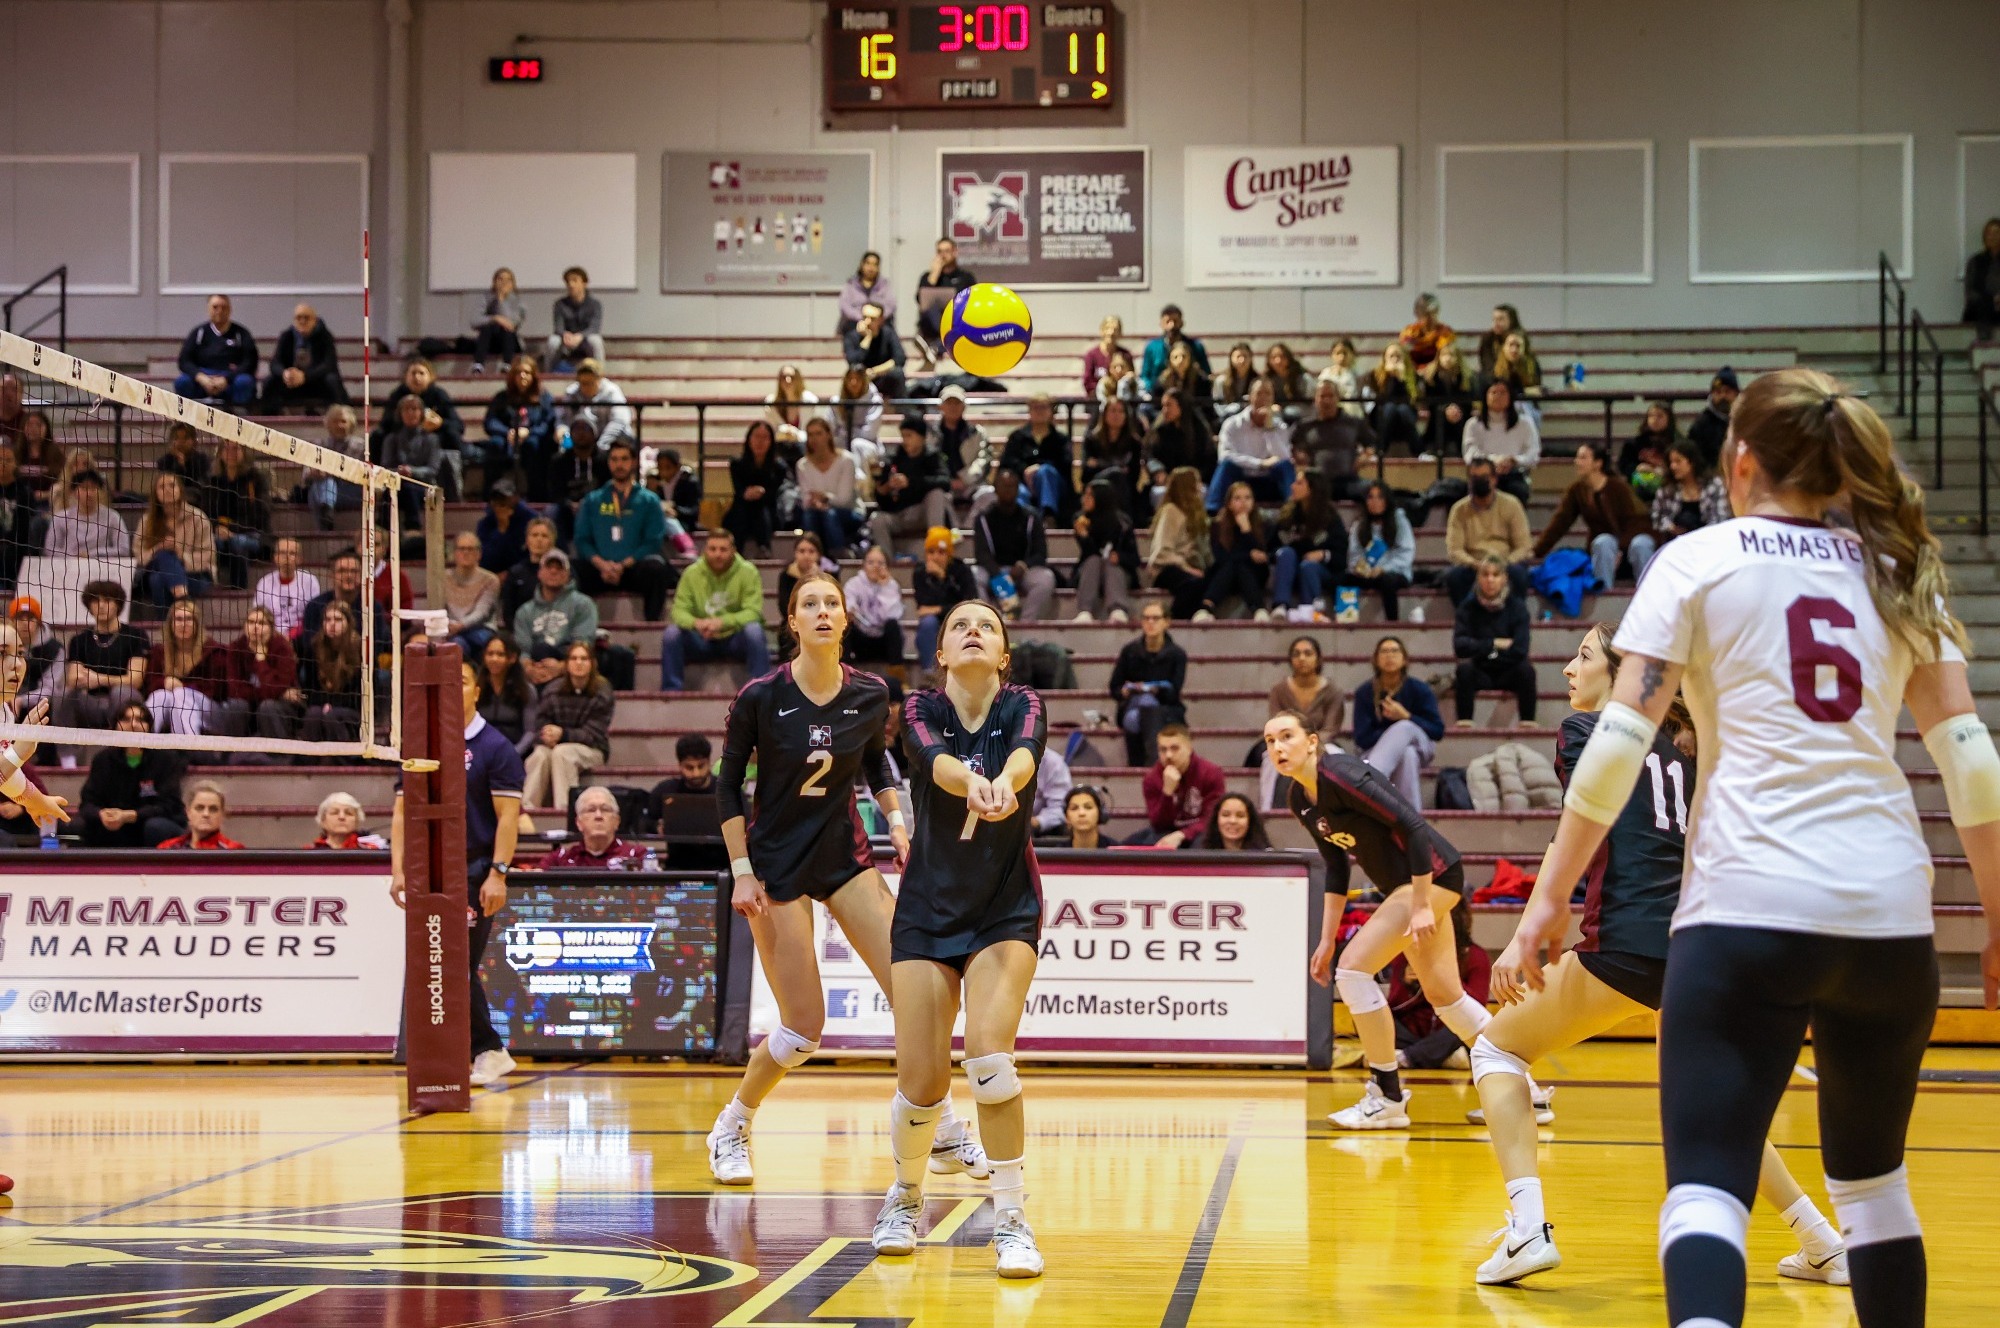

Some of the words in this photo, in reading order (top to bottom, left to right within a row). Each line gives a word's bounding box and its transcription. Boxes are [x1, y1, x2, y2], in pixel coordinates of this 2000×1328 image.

[939, 6, 1029, 50] 3:00
[861, 34, 896, 79] 16
[1069, 33, 1104, 74] 11
[942, 79, 996, 101] period
[1040, 174, 1130, 194] PREPARE.
[1225, 154, 1352, 210] Campus
[1040, 194, 1122, 213] PERSIST.
[1277, 192, 1345, 227] Store
[1040, 212, 1136, 233] PERFORM.
[1738, 529, 1862, 562] McMASTE
[1786, 594, 1863, 722] 6
[800, 750, 833, 796] 2
[1645, 752, 1688, 835] 11
[26, 896, 348, 926] McMASTER
[1043, 898, 1249, 930] ASTER
[29, 936, 336, 957] MARAUDERS
[426, 914, 443, 964] sports
[1040, 939, 1238, 961] AUDERS
[29, 990, 262, 1019] @McMasterSports
[427, 965, 445, 1025] imports
